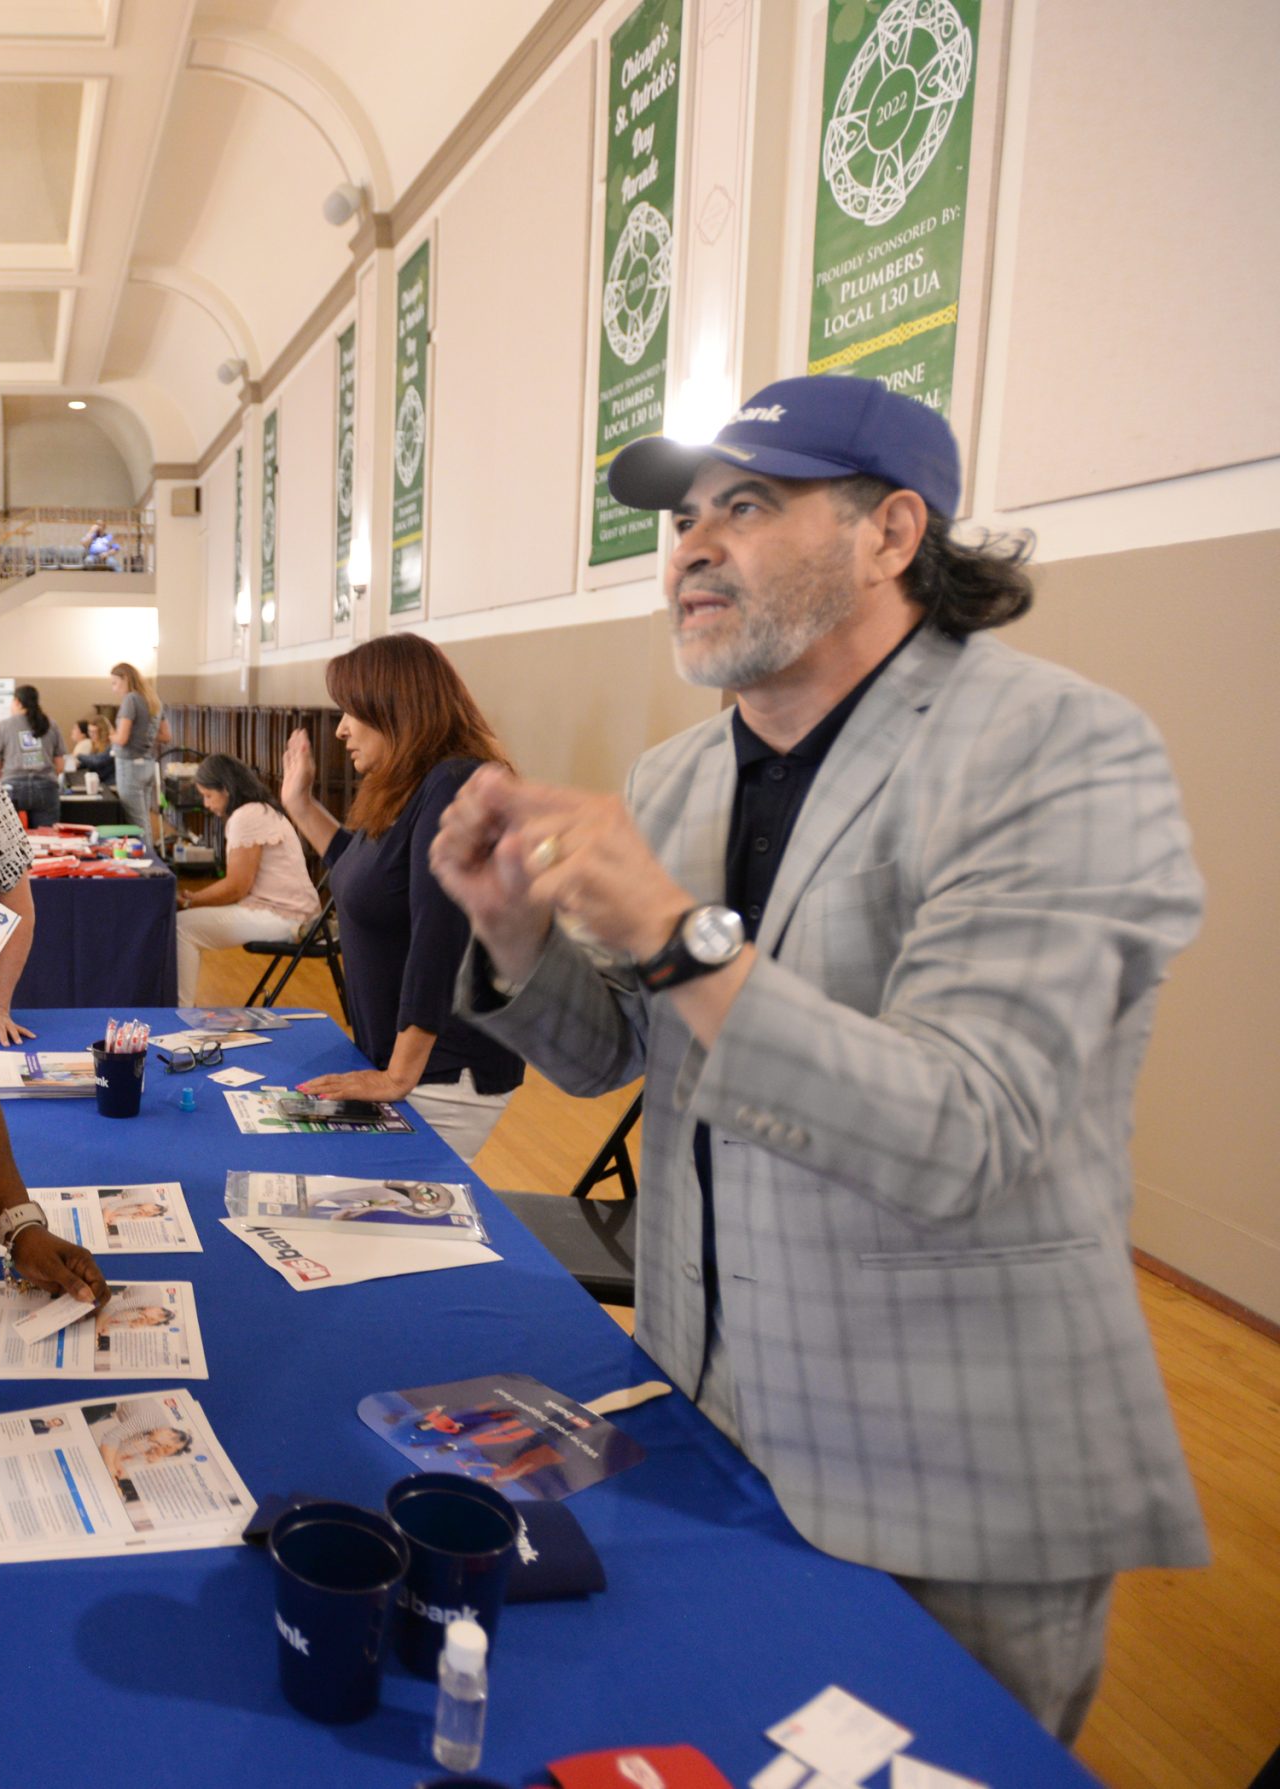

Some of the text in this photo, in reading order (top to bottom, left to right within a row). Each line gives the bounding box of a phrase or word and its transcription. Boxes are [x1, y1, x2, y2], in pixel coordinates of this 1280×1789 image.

[622, 22, 669, 90] Chicago's
[631, 58, 676, 120] Patrick's
[876, 91, 907, 126] 2022
[632, 122, 655, 159] Day
[622, 155, 658, 205] Parade
[816, 254, 864, 288] PROUDLY
[867, 216, 937, 263] SPONSORED
[840, 248, 924, 304] PLUMBERS
[824, 270, 940, 338] LOCAL 130 UA
[612, 384, 654, 417] PLUMBERS
[604, 417, 628, 441] LOCAL
